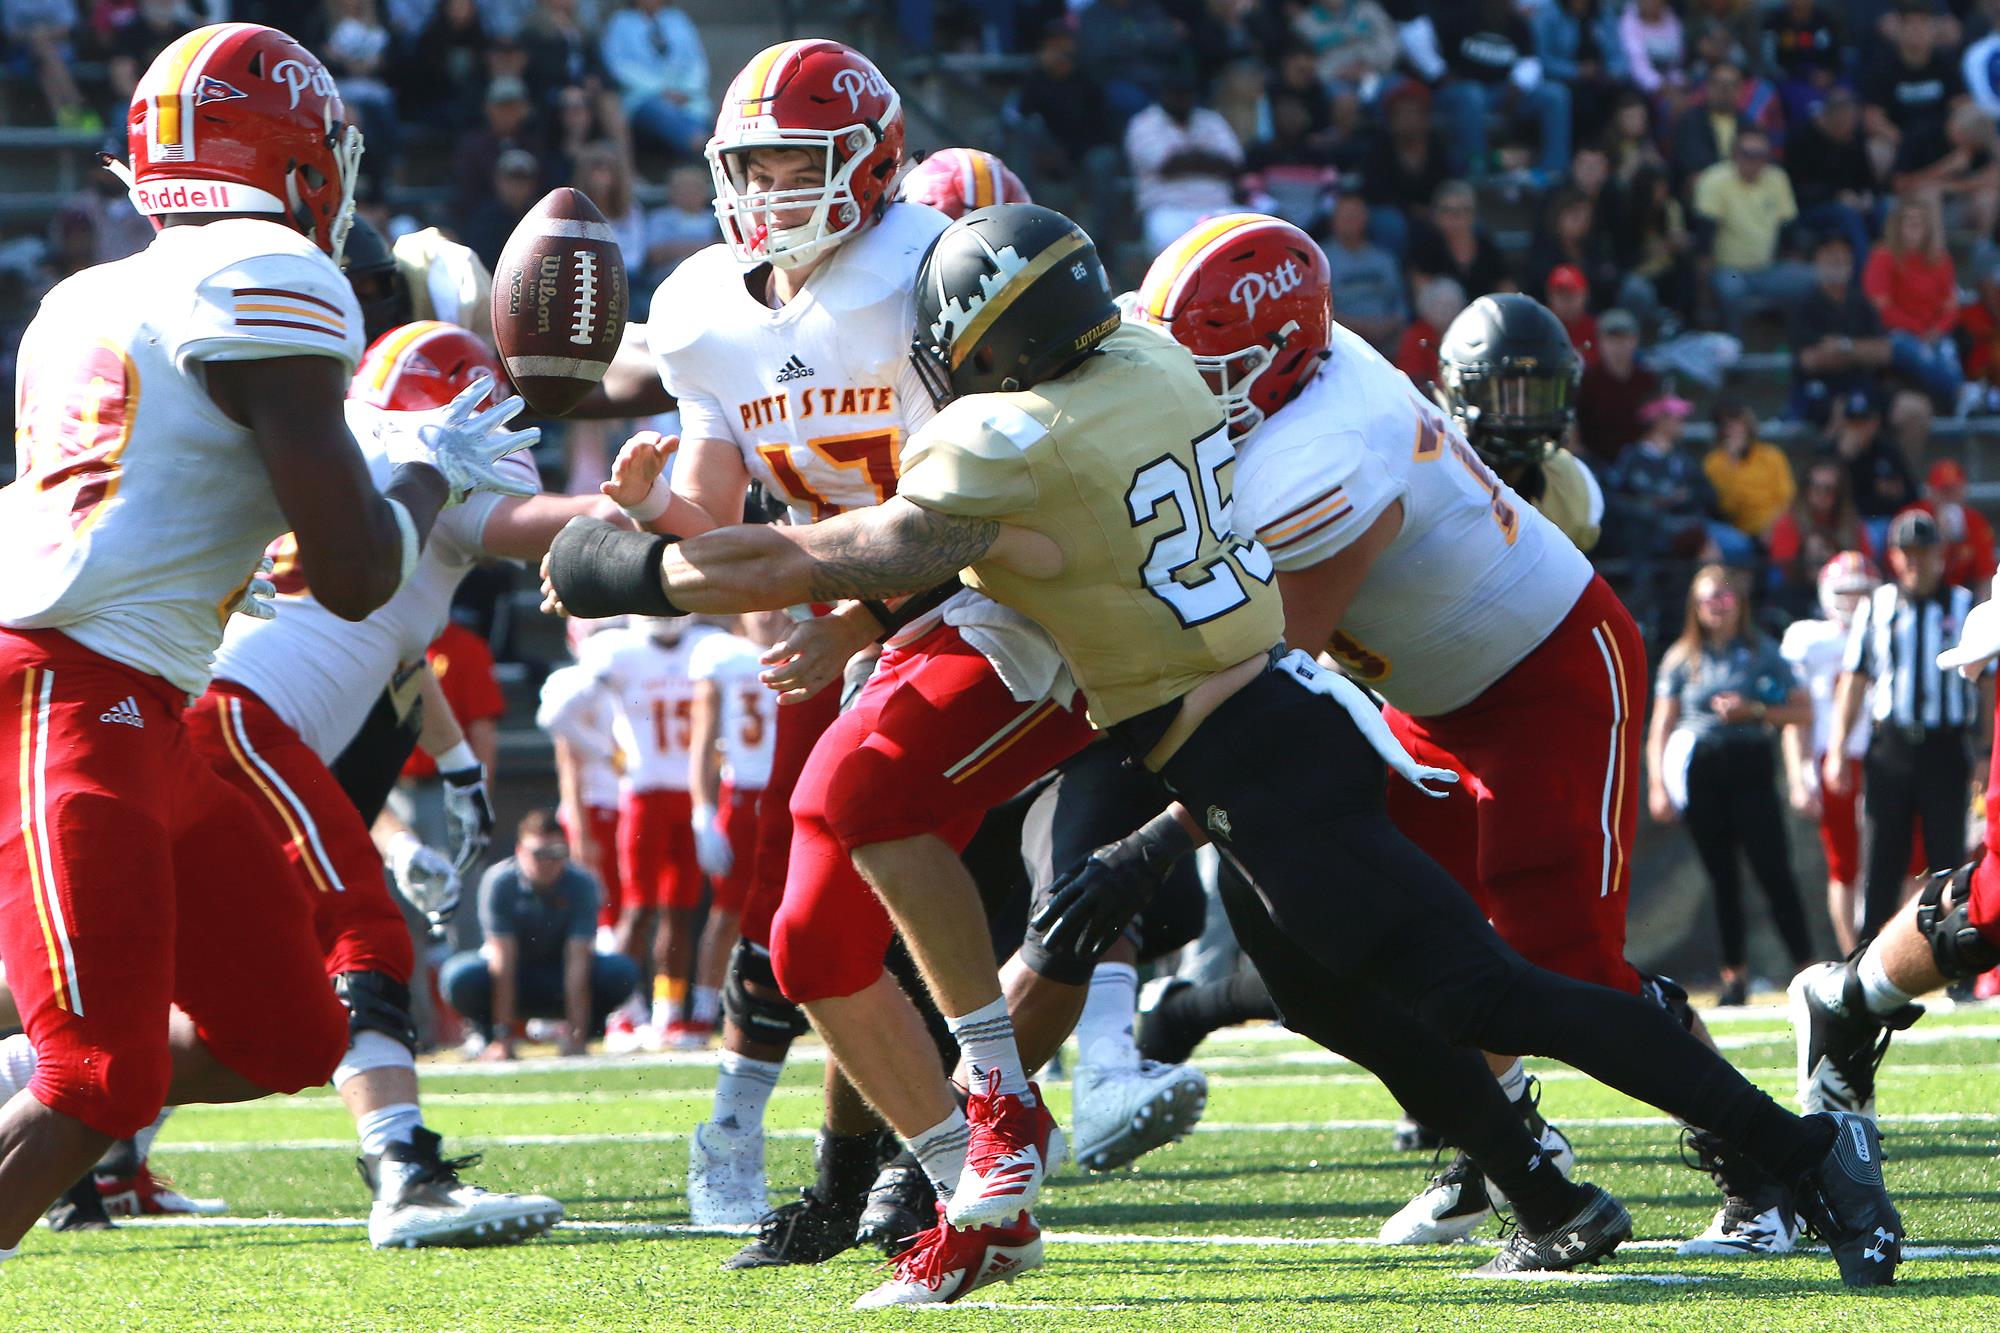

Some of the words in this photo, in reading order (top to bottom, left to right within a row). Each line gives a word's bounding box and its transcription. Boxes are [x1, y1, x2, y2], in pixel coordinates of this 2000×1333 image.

[138, 186, 229, 210] Riddell
[538, 255, 561, 333] Wilson
[1071, 261, 1088, 280] 25
[1229, 258, 1303, 321] Pitt
[602, 265, 620, 343] Wilson
[776, 367, 815, 383] adidas
[739, 394, 788, 431] PITT
[800, 387, 894, 419] STATE
[756, 425, 900, 524] 17
[1124, 417, 1275, 630] 25
